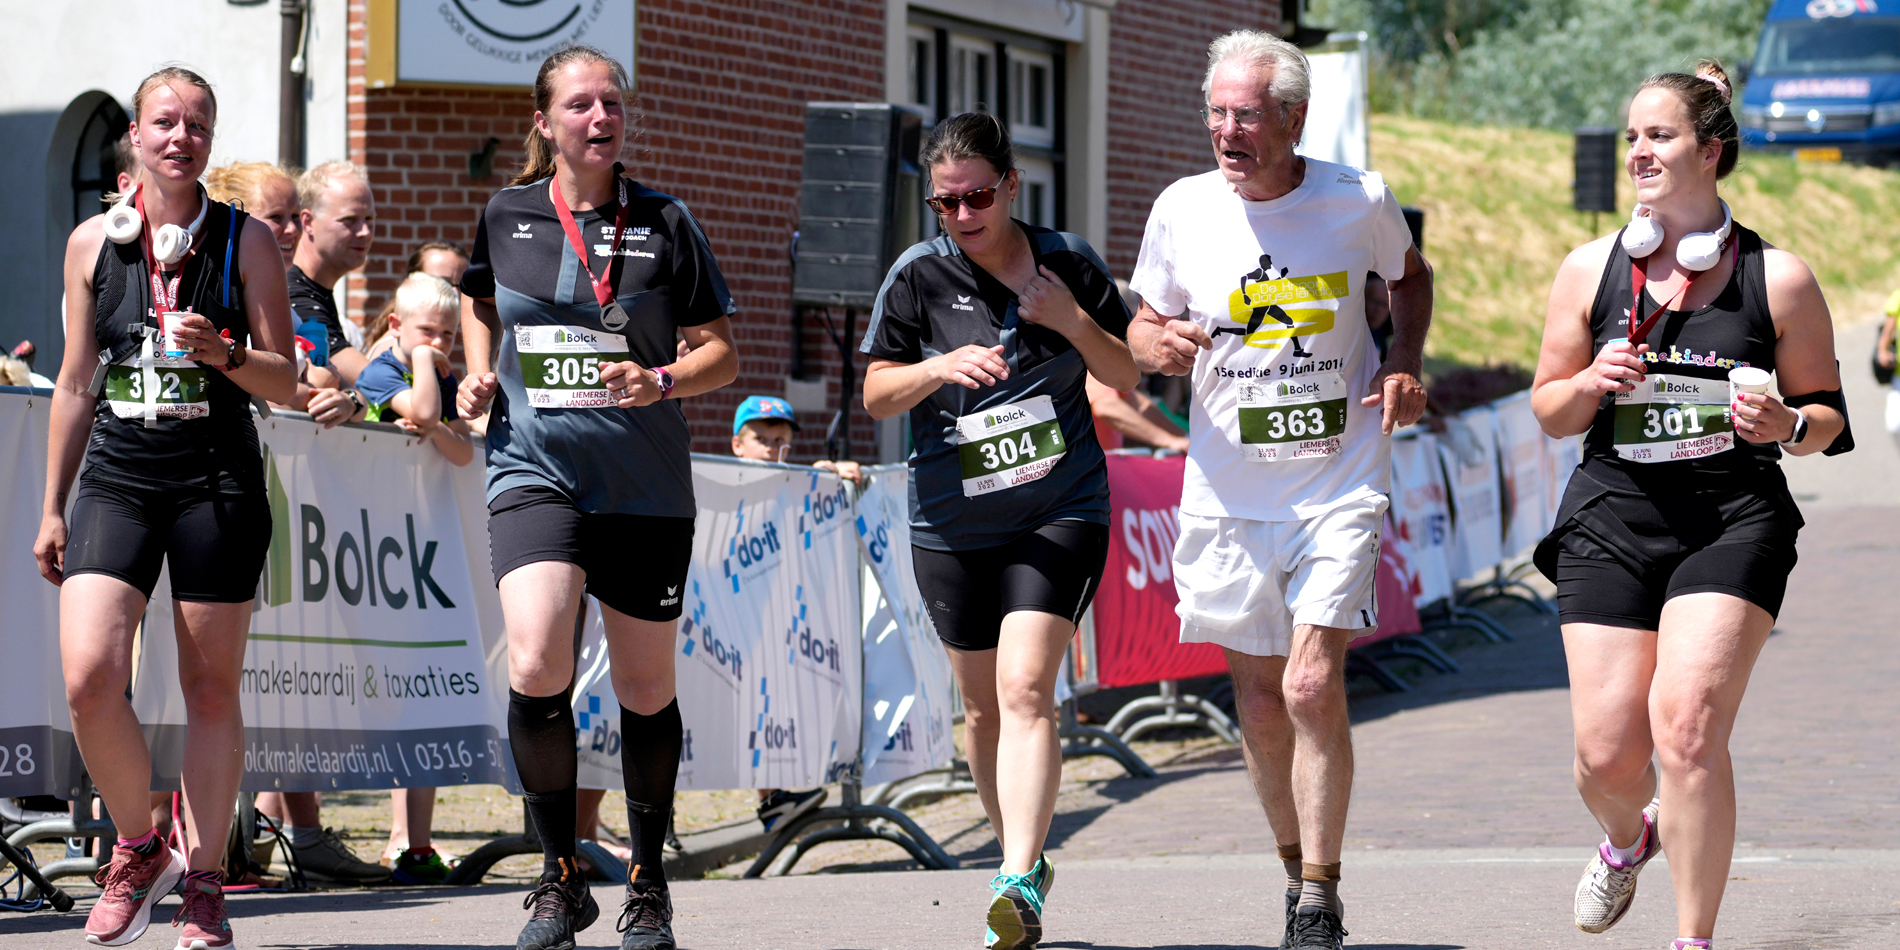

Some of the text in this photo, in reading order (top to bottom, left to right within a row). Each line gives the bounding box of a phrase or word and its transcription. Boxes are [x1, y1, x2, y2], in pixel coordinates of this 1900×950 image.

[601, 226, 651, 235] STFANIE
[1260, 280, 1324, 294] De Kroon
[1295, 286, 1346, 299] landloop
[952, 303, 974, 311] erima
[567, 333, 597, 343] Bolck
[542, 358, 600, 386] 305
[1214, 367, 1235, 378] 15e
[1279, 364, 1288, 376] 9
[1290, 361, 1315, 377] juni
[1290, 382, 1320, 395] Bolck
[1667, 382, 1700, 394] Bolck
[566, 399, 607, 407] LANDLOOP
[996, 409, 1026, 424] Bolck
[1267, 407, 1325, 439] 363
[1643, 407, 1704, 438] 301
[980, 431, 1037, 469] 304
[1676, 437, 1713, 450] LIEMERSE
[1670, 446, 1714, 459] LANDLOOP
[1015, 460, 1049, 476] LIEMERSE
[1011, 468, 1050, 485] LANDLOOP
[978, 482, 995, 490] 2023
[300, 503, 457, 610] Bolck
[241, 660, 480, 706] makelaardij & taxaties
[415, 740, 473, 771] 0316
